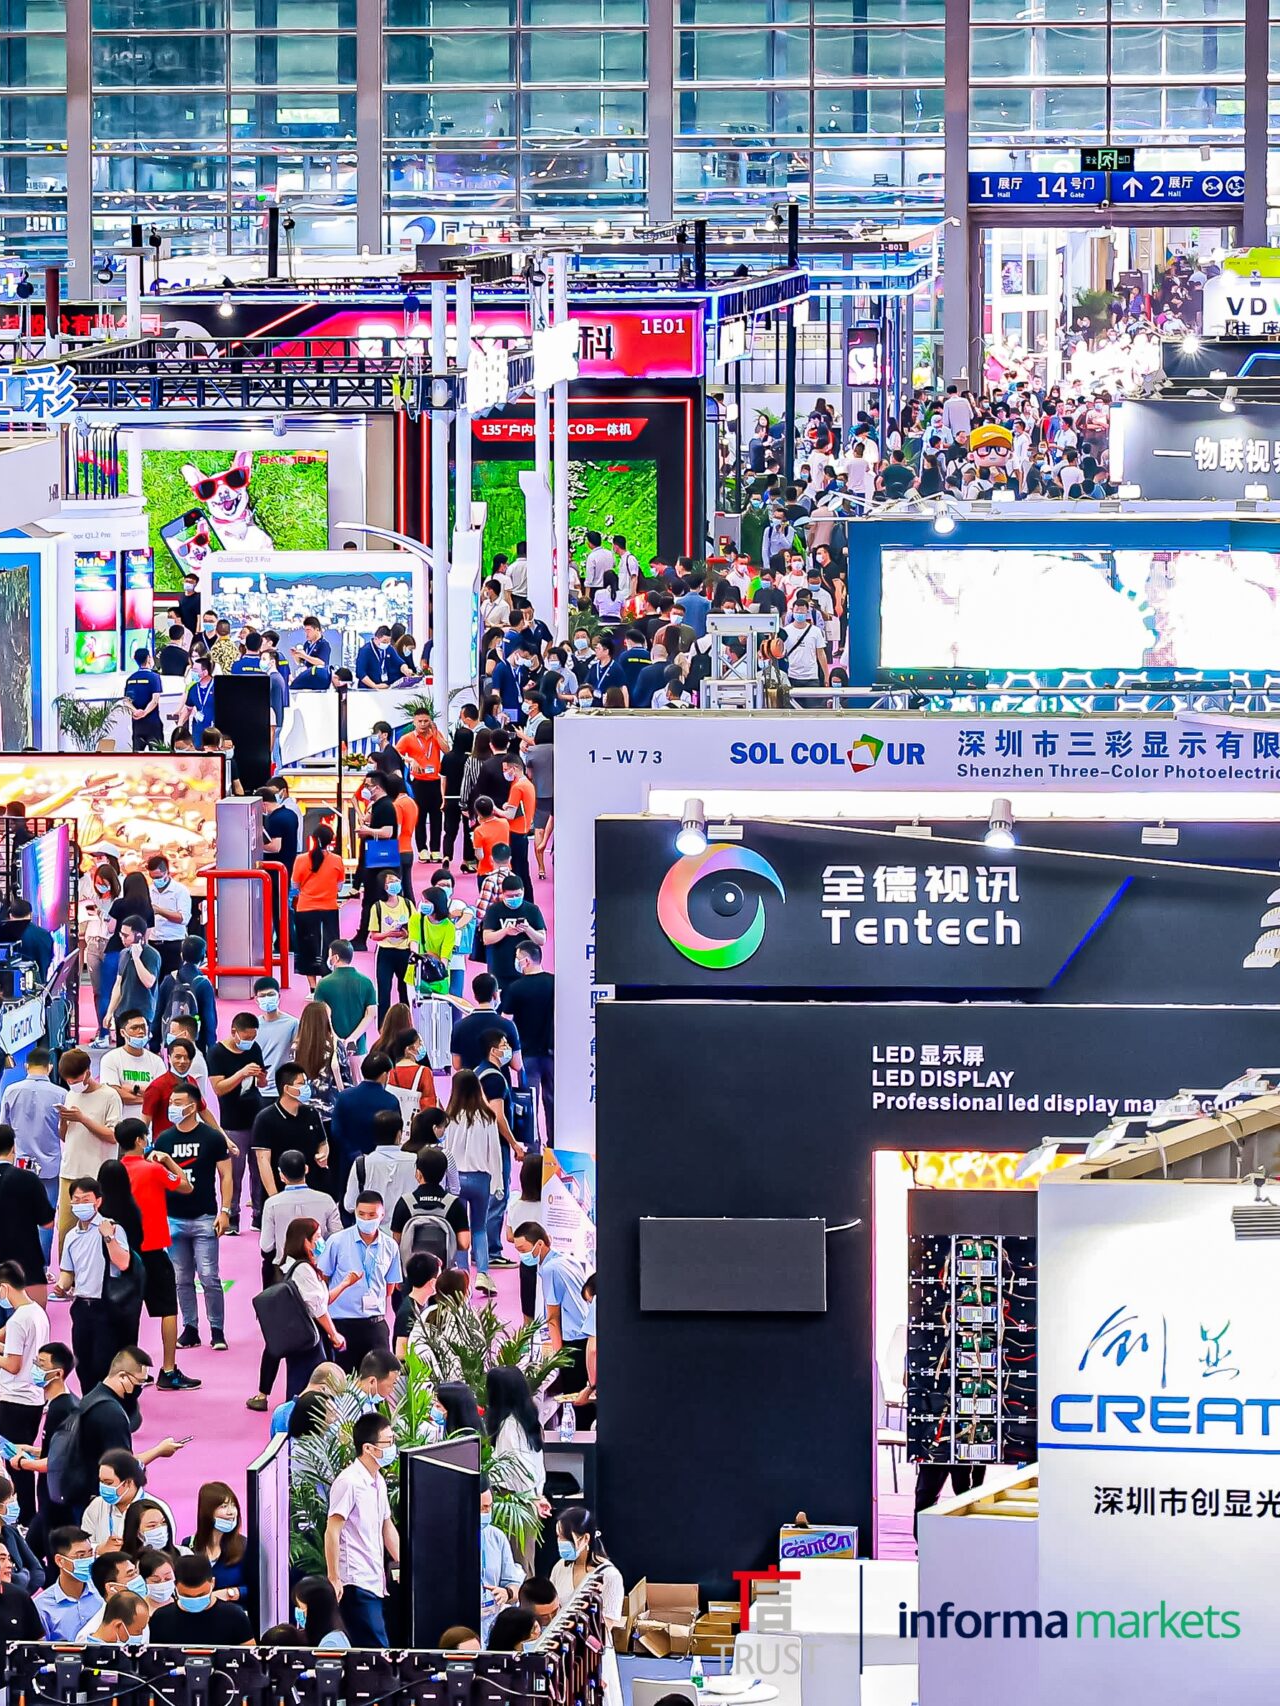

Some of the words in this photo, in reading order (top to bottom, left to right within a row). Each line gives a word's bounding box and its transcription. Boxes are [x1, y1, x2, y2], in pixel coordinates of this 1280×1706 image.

[981, 177, 994, 198] 1
[998, 177, 1022, 190] 展厅
[1037, 177, 1067, 198] 14
[1070, 177, 1095, 190] 号门
[1070, 191, 1085, 199] Gate
[1150, 176, 1164, 198] 2
[1168, 177, 1193, 190] 展厅
[1226, 296, 1280, 316] VD
[641, 319, 686, 335] 1E01
[1194, 436, 1280, 473] 物联视
[730, 742, 784, 765] SOL
[957, 729, 1280, 759] 深圳市三彩显示有限
[956, 763, 1044, 778] Shenzhen
[1048, 763, 1159, 779] Three-Color
[821, 864, 1020, 904] 全德视讯
[821, 909, 1021, 945] Tentech
[872, 1045, 915, 1064] LED
[920, 1044, 984, 1067] 显示屏
[872, 1069, 915, 1087] LED
[921, 1070, 1015, 1089] DISPLAY
[872, 1091, 1003, 1111] Professional
[1008, 1093, 1040, 1112] led
[1043, 1094, 1121, 1117] display
[171, 1143, 200, 1159] JUST
[1051, 1394, 1280, 1436] CREAT
[1094, 1485, 1280, 1518] 深圳市创显光
